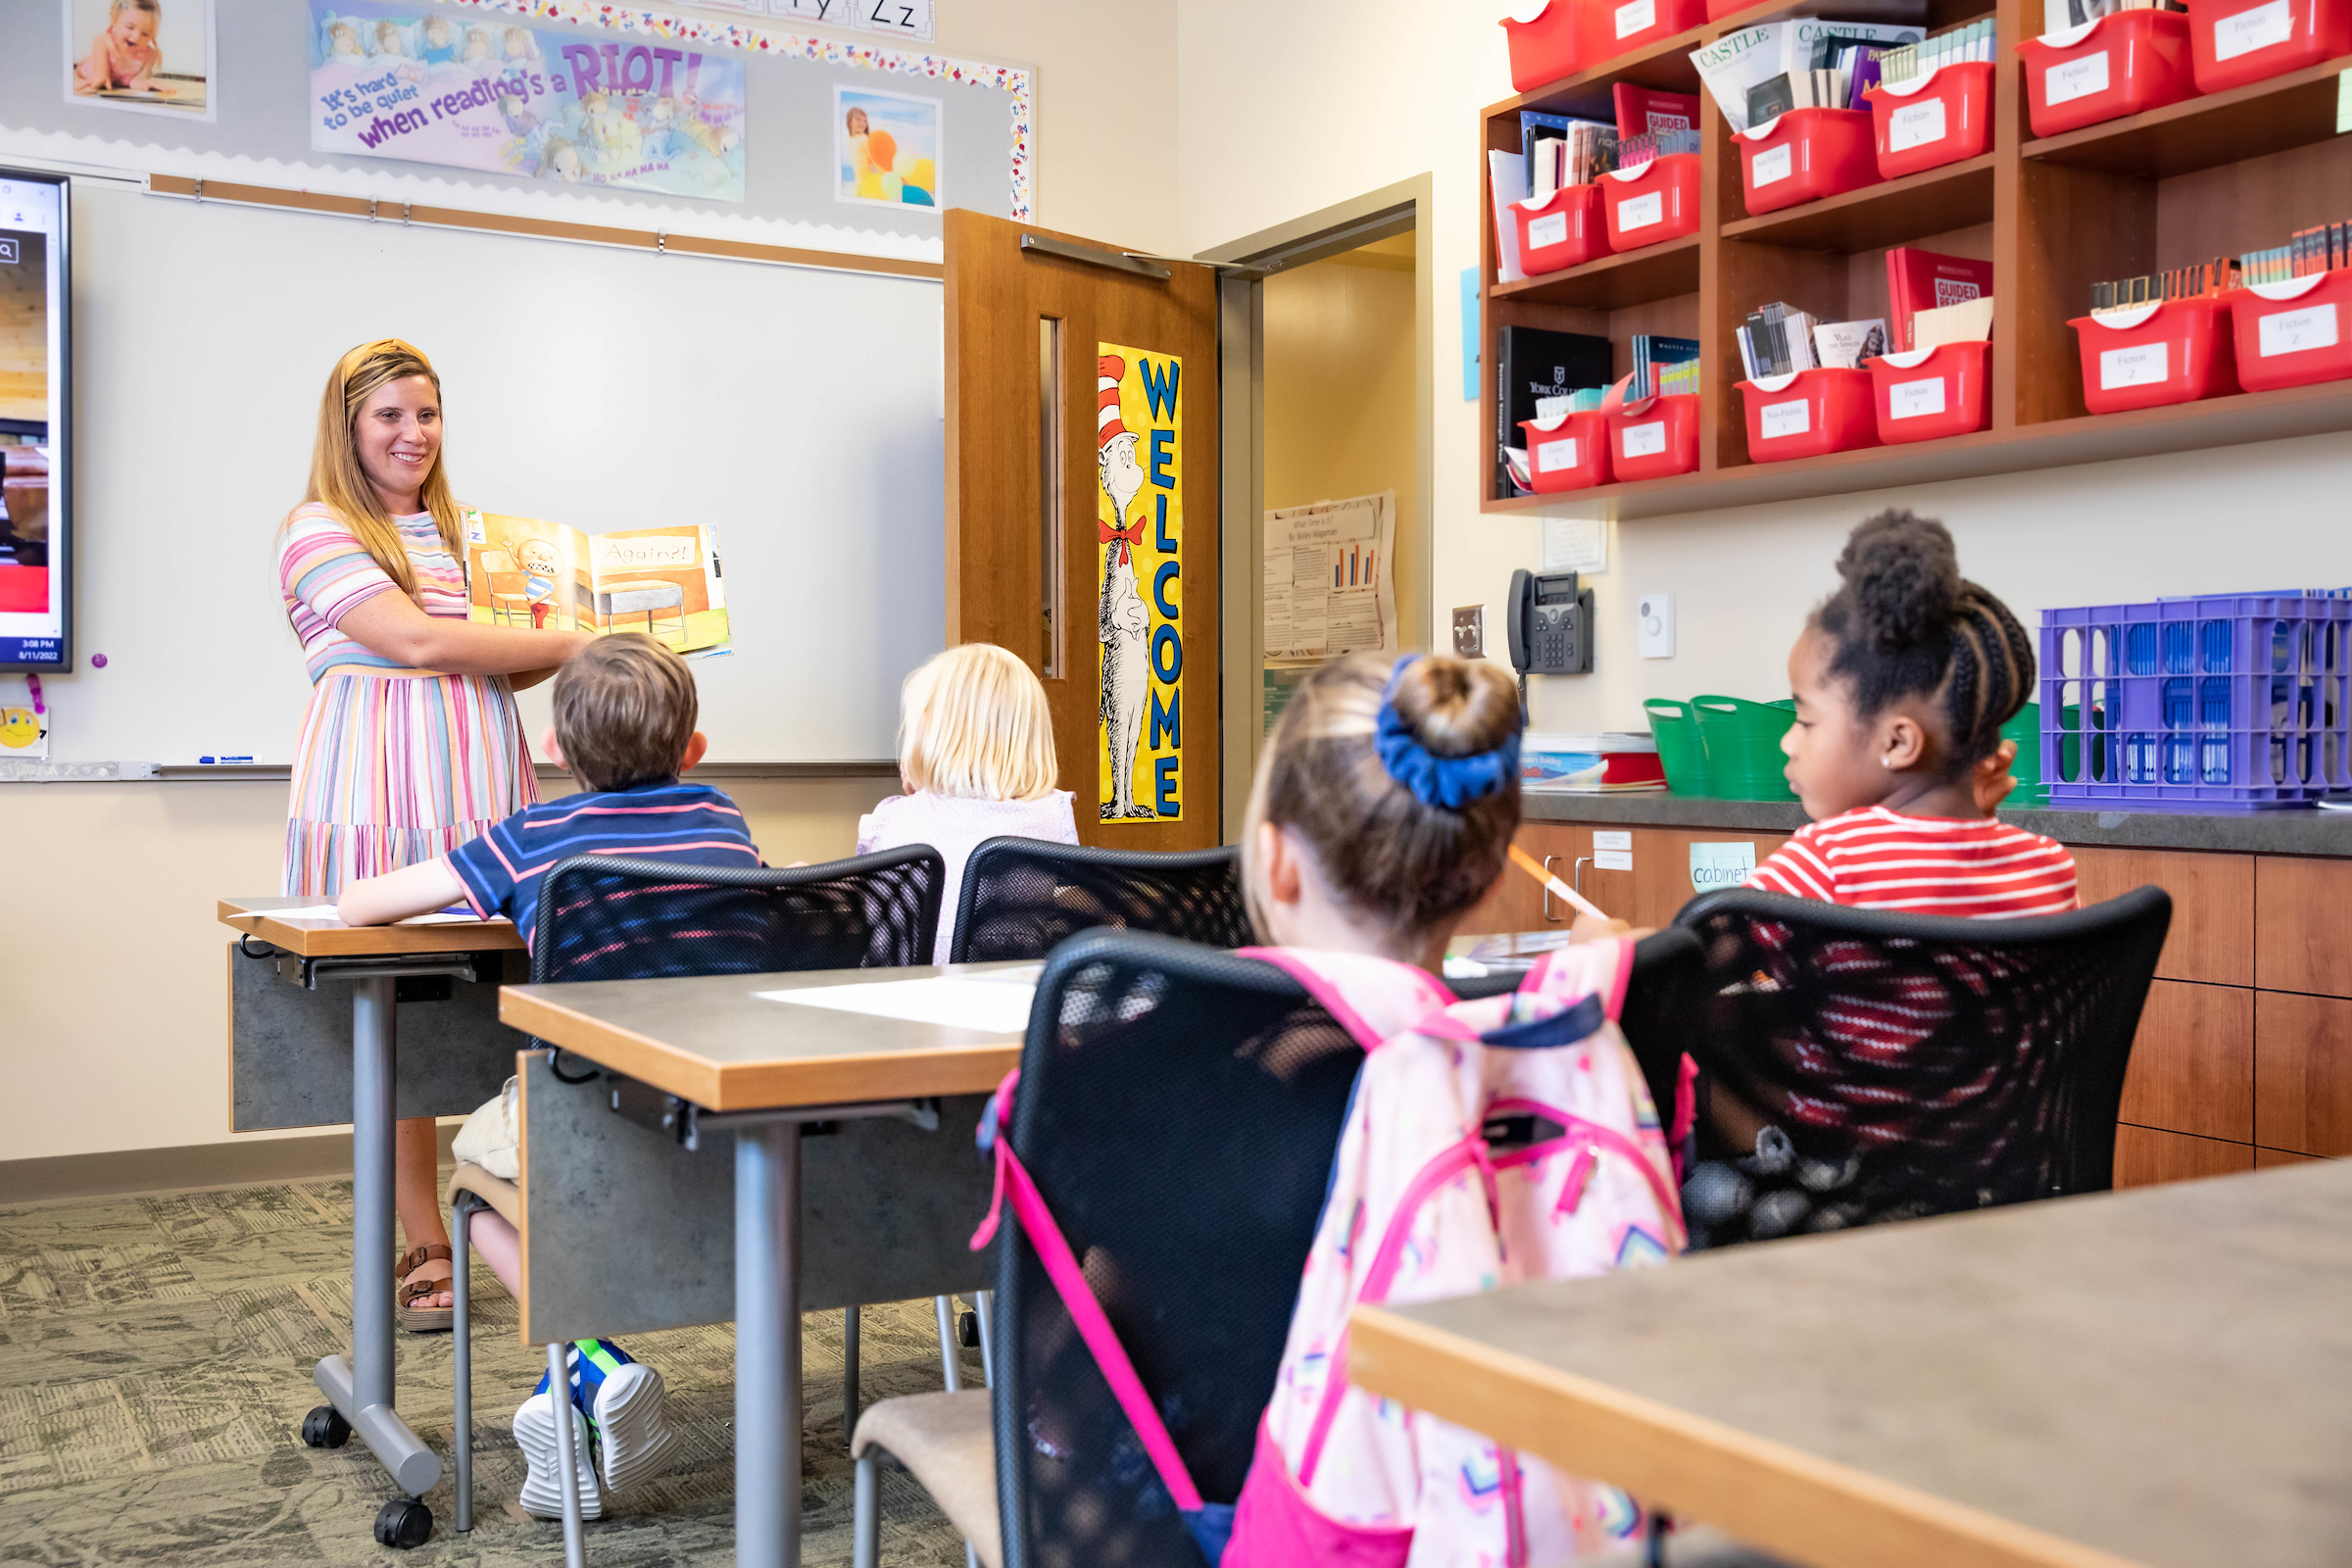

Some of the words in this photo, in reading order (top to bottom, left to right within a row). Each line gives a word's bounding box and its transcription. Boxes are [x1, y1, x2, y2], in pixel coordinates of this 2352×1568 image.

[2234, 15, 2267, 32] Fiction
[1699, 27, 1769, 68] CASTLE
[2061, 63, 2090, 79] Fiction
[320, 88, 358, 112] It's
[354, 72, 399, 96] hard
[358, 108, 429, 149] when
[430, 69, 545, 120] reading's
[551, 74, 567, 92] a
[561, 43, 704, 102] RIOT!
[323, 113, 348, 130] to
[347, 101, 373, 119] be
[376, 84, 419, 111] quiet
[1648, 114, 1689, 130] GUIDED
[1902, 111, 1930, 124] Fiction
[1937, 281, 1979, 300] GUIDED
[2278, 316, 2312, 331] Fiction
[2117, 352, 2146, 366] Fiction
[1904, 386, 1928, 398] Fiction
[606, 544, 686, 564] Again?!
[1140, 358, 1183, 817] WELCOME
[23, 639, 39, 648] 3:08
[19, 651, 59, 661] 8/11/2022
[1693, 856, 1749, 884] cabinet
